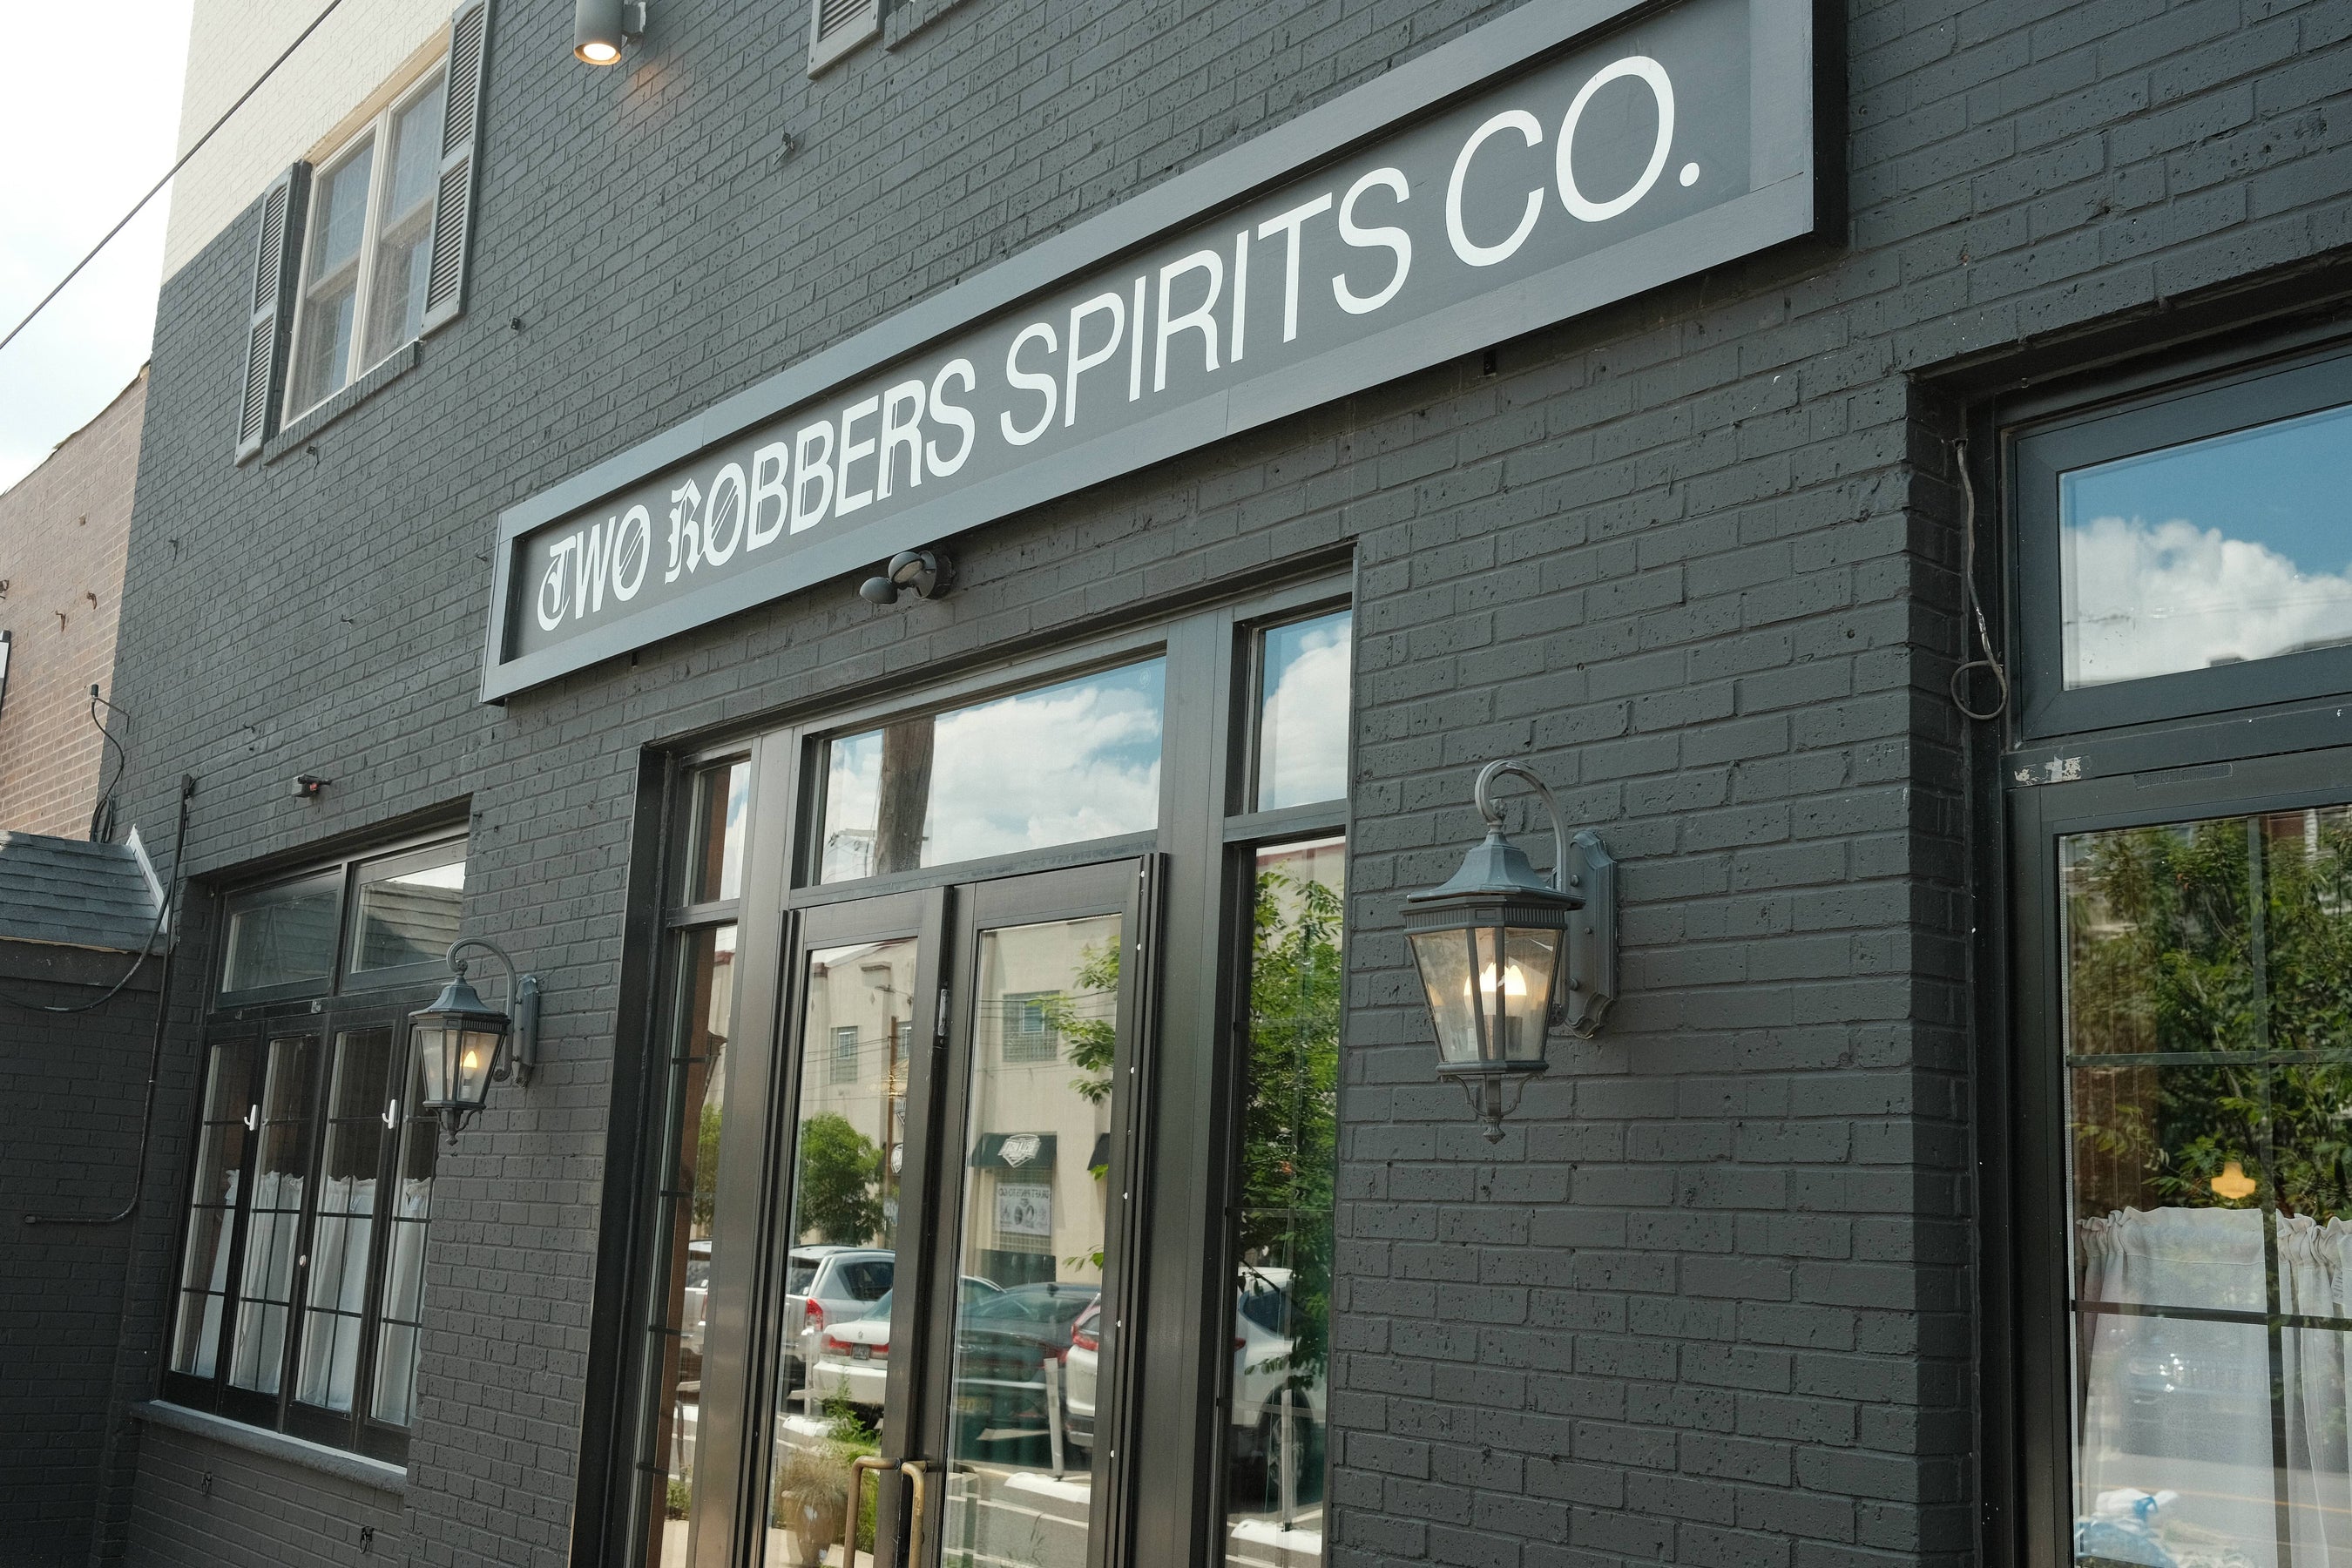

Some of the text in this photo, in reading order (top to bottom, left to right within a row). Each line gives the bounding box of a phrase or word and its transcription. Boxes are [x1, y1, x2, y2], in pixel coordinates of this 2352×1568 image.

[537, 55, 1700, 632] TWO ROBBERS SPIRITS CO.
